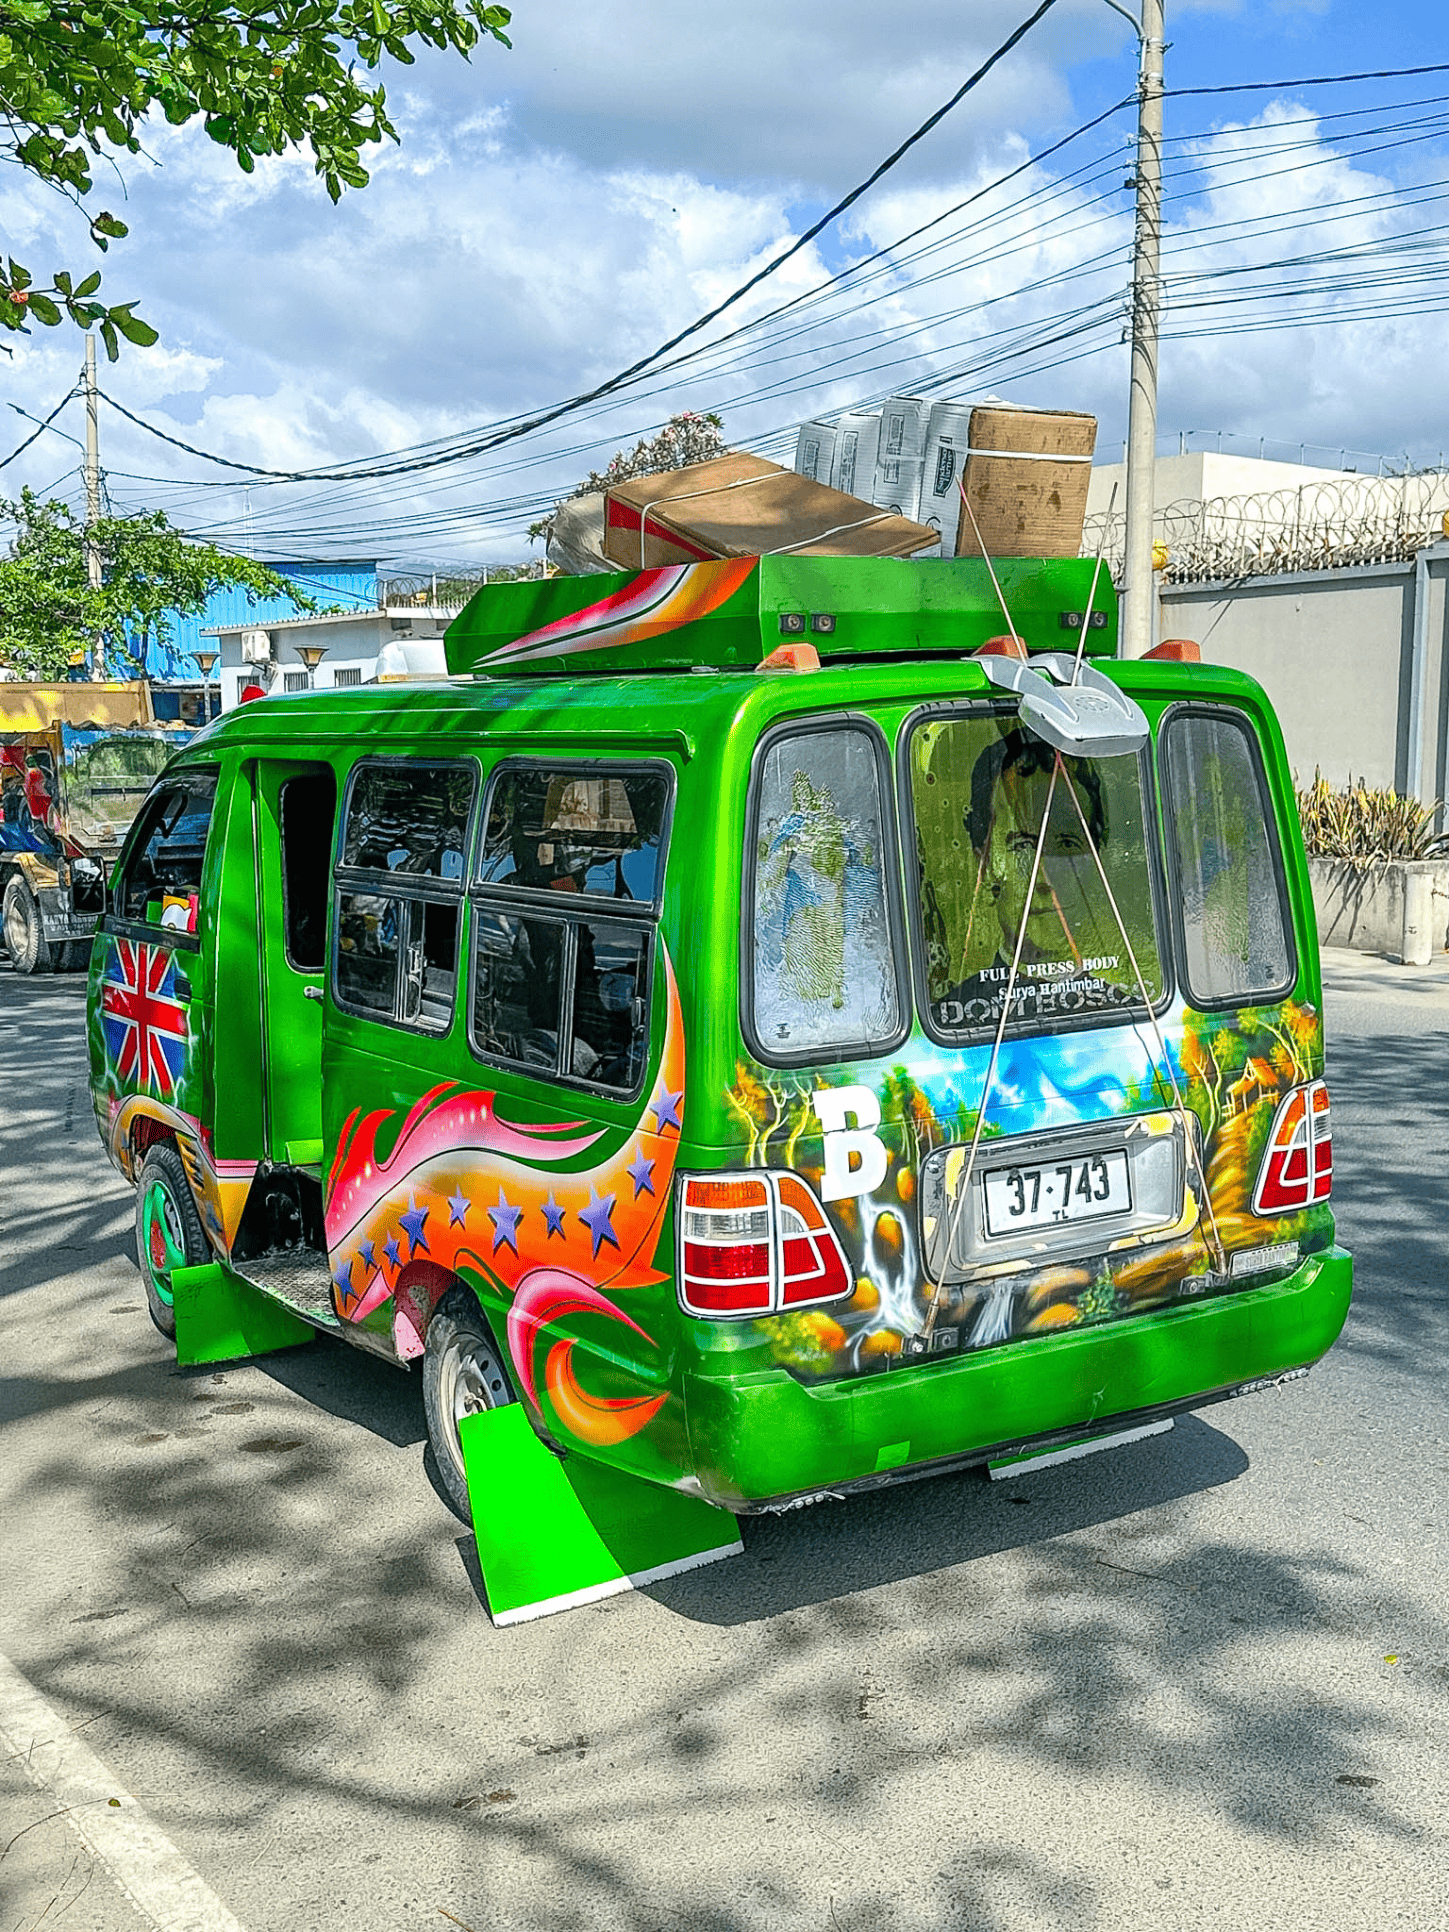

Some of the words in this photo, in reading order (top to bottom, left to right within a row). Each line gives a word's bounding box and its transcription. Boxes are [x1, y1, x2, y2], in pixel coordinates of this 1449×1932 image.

[979, 967, 1019, 982] FULL
[1026, 960, 1075, 977] PRESS
[1082, 956, 1120, 973] BODY
[998, 985, 1036, 1001] Surya
[1039, 977, 1106, 996] Hantimbar
[940, 996, 1025, 1024] DOM
[813, 1084, 888, 1203] B
[1052, 1209, 1069, 1221] TL
